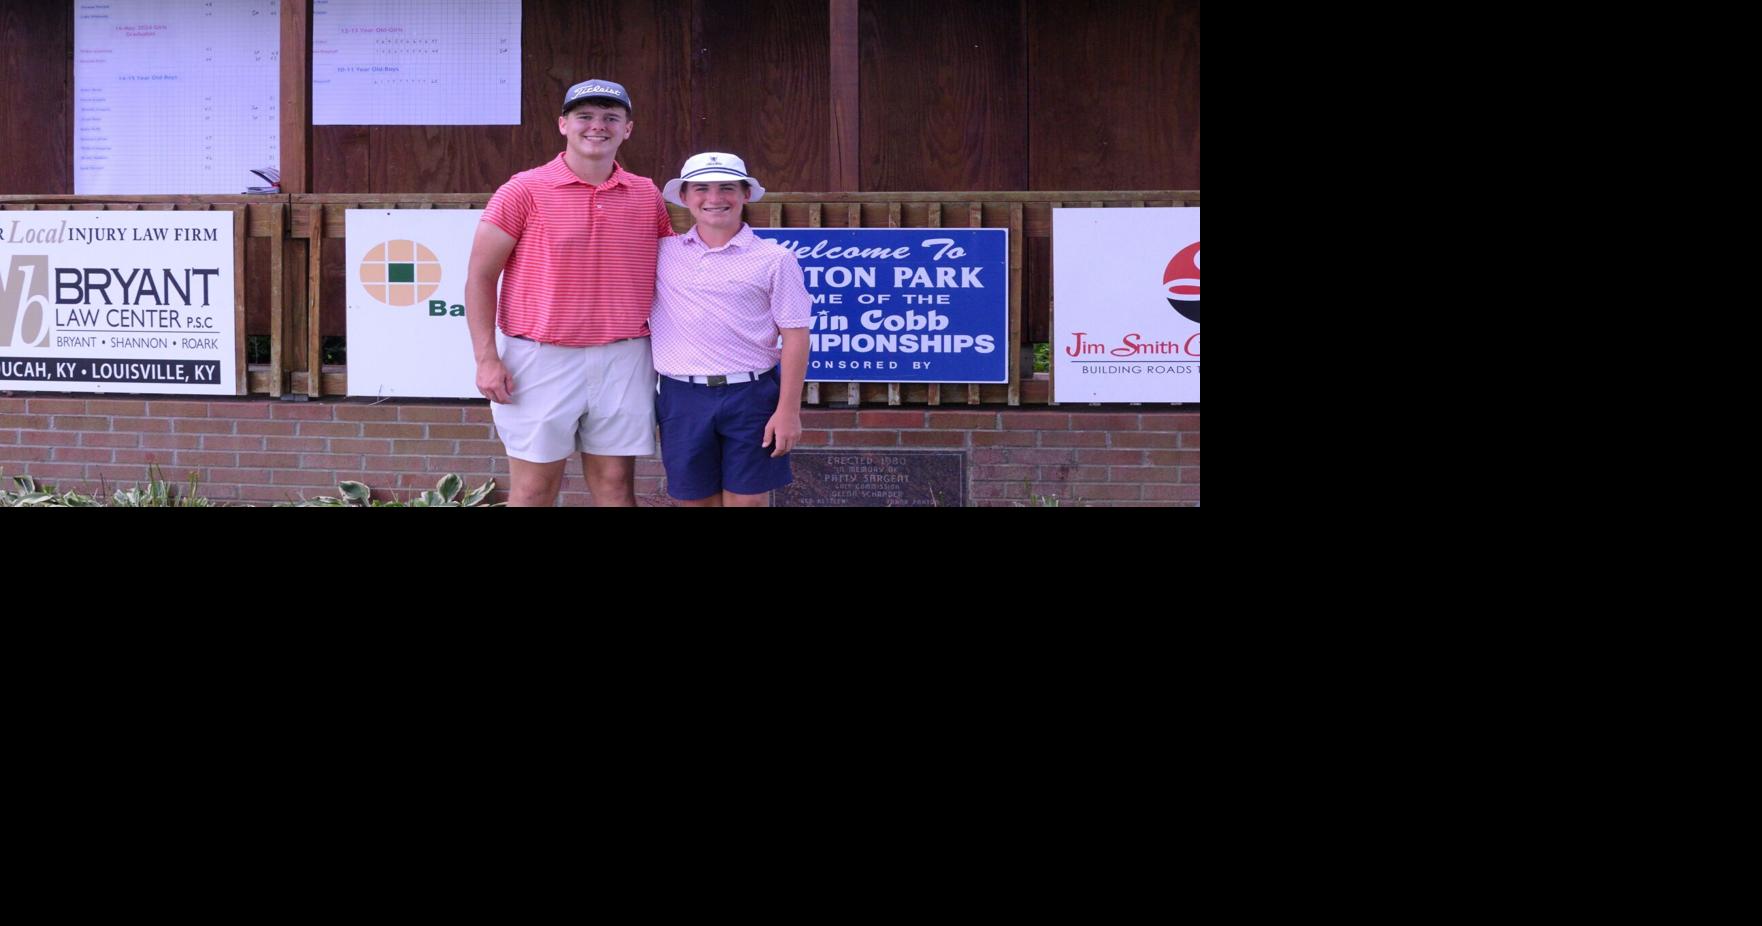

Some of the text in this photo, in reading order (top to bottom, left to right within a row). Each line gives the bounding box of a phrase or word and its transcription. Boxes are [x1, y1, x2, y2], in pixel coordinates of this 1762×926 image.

[8, 220, 66, 244] Local
[68, 228, 127, 245] INJURY
[132, 228, 168, 241] LAW
[174, 228, 218, 241] FIRM
[921, 238, 967, 261] To
[55, 267, 219, 307] BRYANT
[893, 266, 985, 288] PARK
[858, 294, 891, 304] OF
[902, 294, 951, 304] THE
[56, 309, 100, 327] LAW
[106, 309, 181, 328] CENTER
[860, 309, 949, 332] Cobb
[57, 337, 218, 349] BRYANT SHANNON ROARK
[1066, 332, 1105, 357] Jim
[1110, 333, 1179, 357] Smith
[0, 361, 215, 382] UCAH, KY LOUISVILLE, KY
[807, 361, 931, 370] ONSORED BY
[1082, 365, 1142, 374] BUILDING
[1147, 365, 1192, 374] ROADS
[827, 456, 873, 465] ERECTED
[825, 474, 910, 483] PATTY SARGENT
